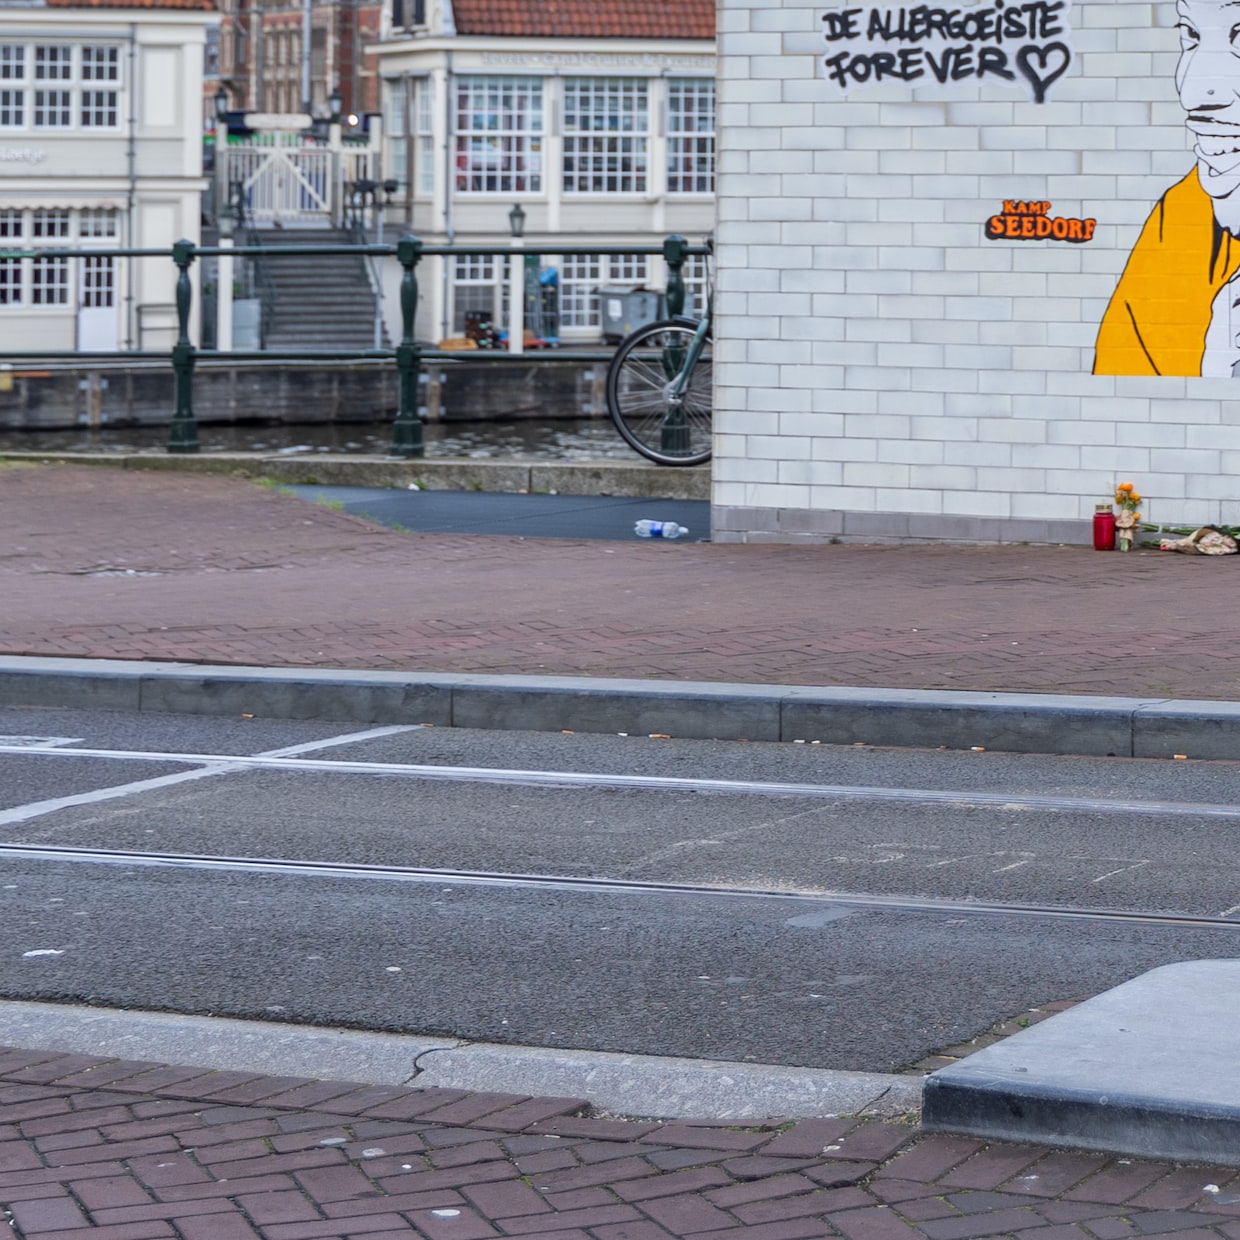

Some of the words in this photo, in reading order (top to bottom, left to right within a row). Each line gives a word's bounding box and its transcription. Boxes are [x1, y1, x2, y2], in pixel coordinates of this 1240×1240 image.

[822, 8, 863, 41] DE
[825, 43, 1016, 88] FOREVER
[1003, 199, 1052, 215] KAMP
[990, 215, 1097, 240] SEEDORF
